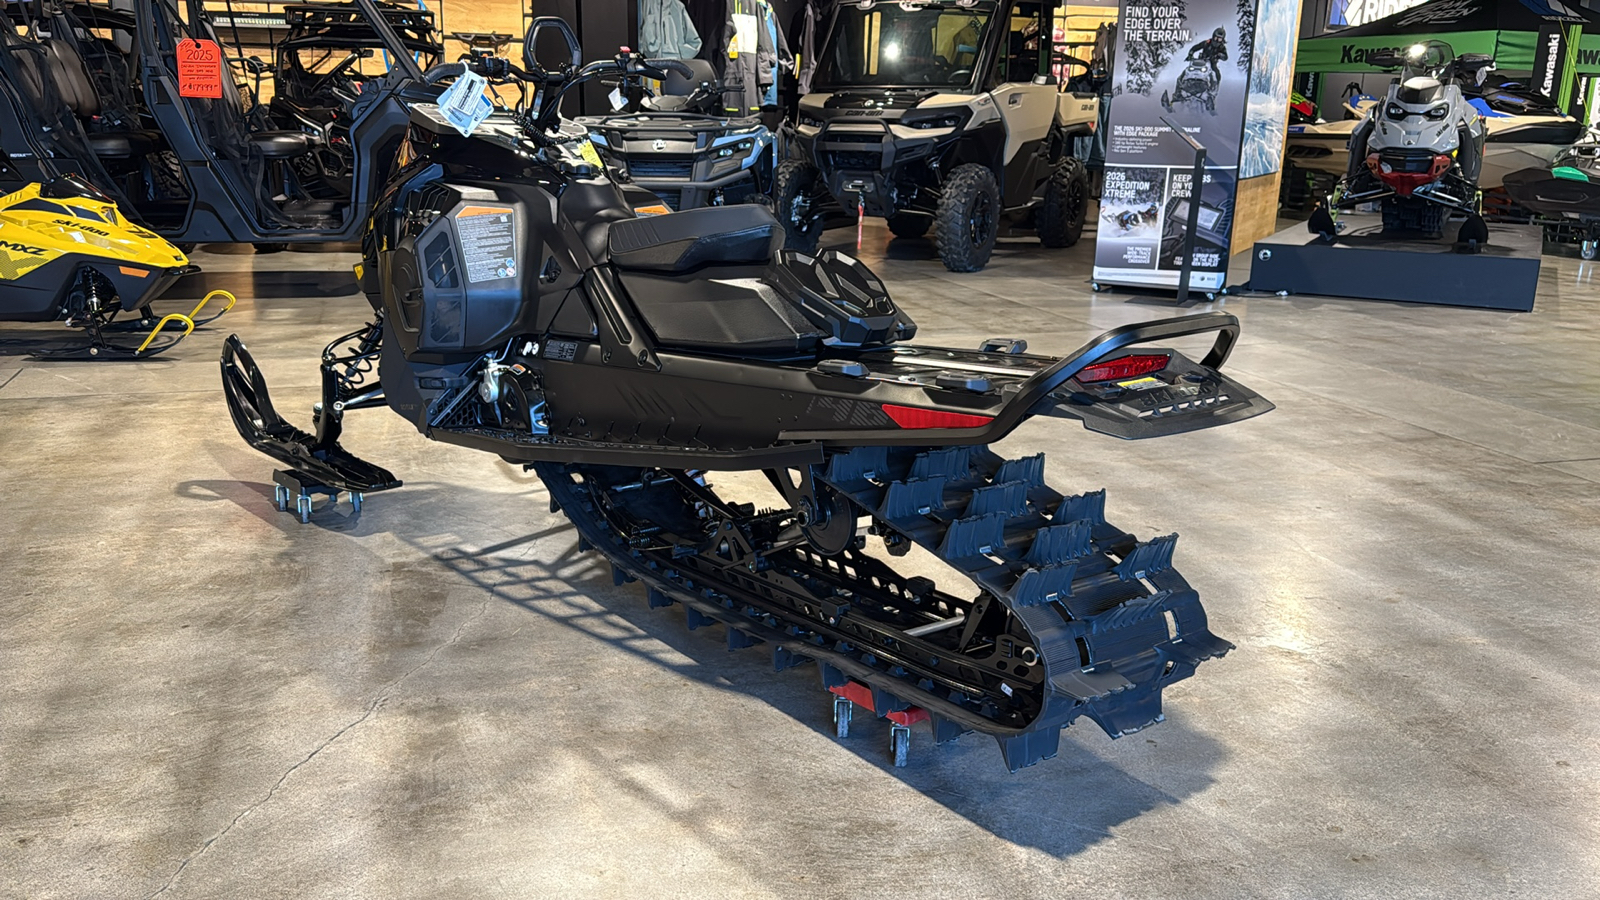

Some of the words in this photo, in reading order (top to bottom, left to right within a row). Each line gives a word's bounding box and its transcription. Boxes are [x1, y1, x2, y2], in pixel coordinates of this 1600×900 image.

[1125, 6, 1149, 18] FIND
[1152, 6, 1180, 18] YOUR
[1124, 18, 1151, 30] EDGE
[1153, 18, 1182, 30] OVER
[1123, 30, 1143, 41] THE
[1145, 30, 1192, 42] TERRAIN.
[186, 49, 214, 61] 2025
[1540, 33, 1561, 98] Kawasaki
[1106, 172, 1126, 181] 2026
[1172, 174, 1193, 182] KEEP
[1105, 181, 1151, 191] EXPEDITION
[1172, 182, 1182, 190] ON
[1104, 190, 1136, 199] XTREME
[52, 219, 110, 237] ski-doo
[0, 241, 49, 256] MXZ
